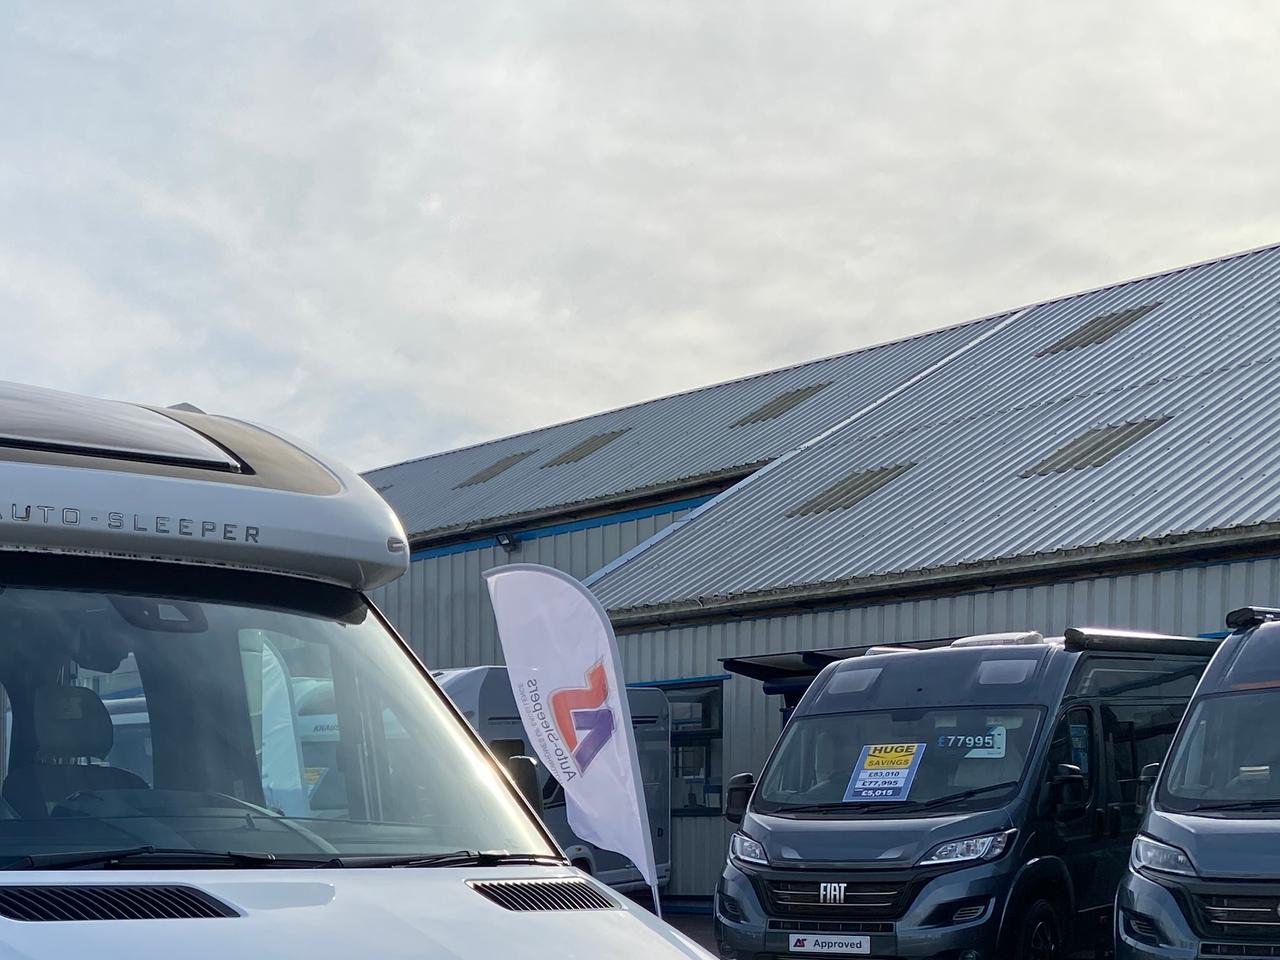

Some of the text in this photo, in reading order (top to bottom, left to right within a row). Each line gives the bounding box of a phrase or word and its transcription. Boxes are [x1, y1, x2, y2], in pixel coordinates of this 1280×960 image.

[872, 745, 915, 754] HUGE
[867, 759, 909, 767] SAVINGS
[861, 789, 893, 797] £5,015
[820, 883, 847, 903] FIAT
[813, 939, 862, 949] Approved
